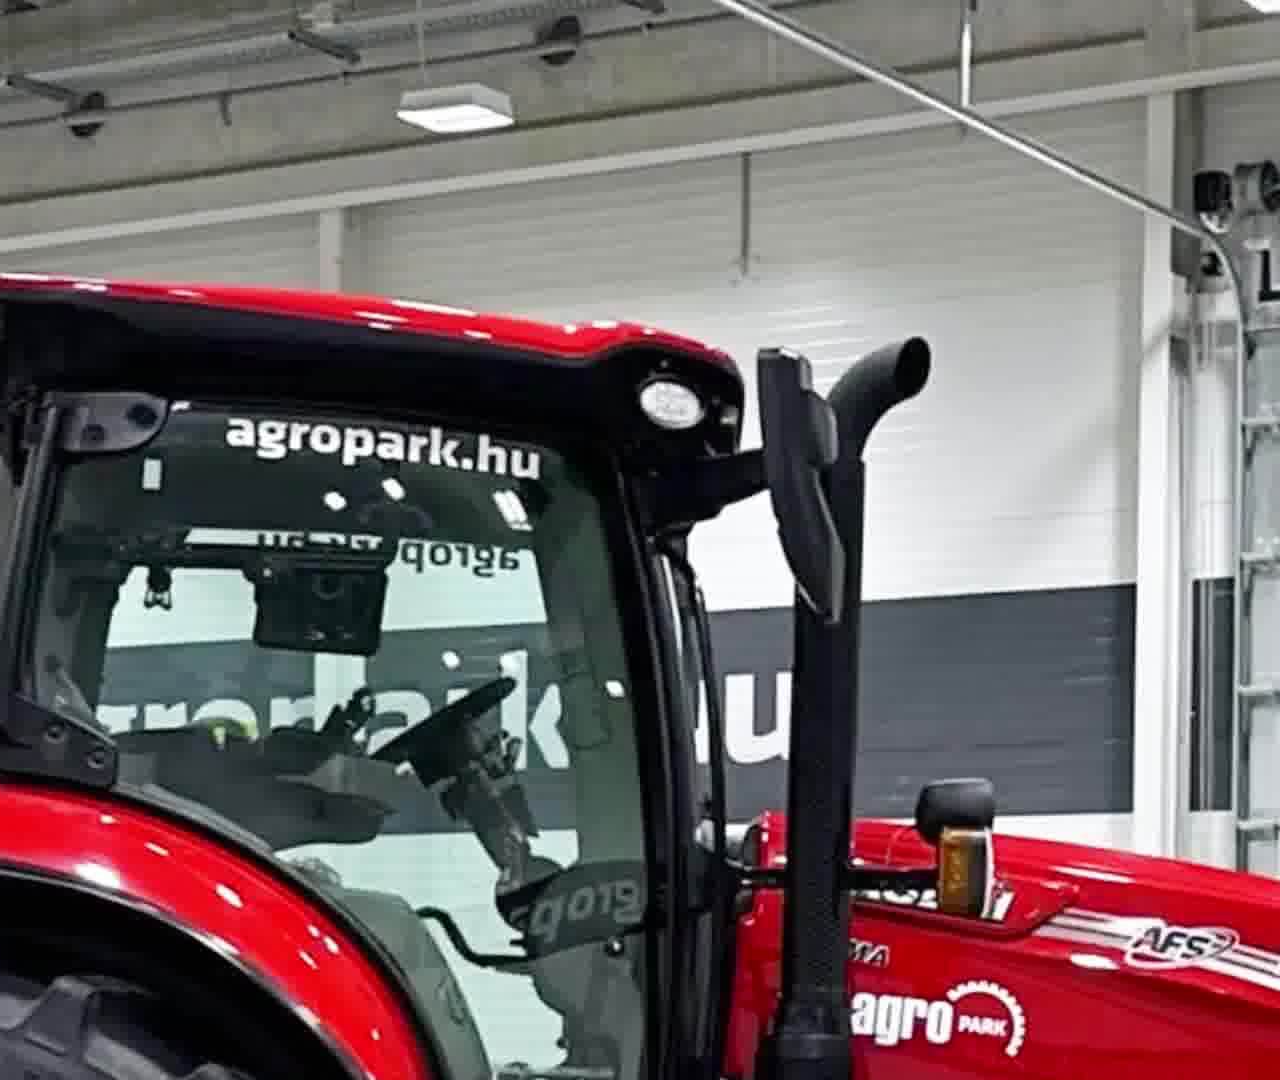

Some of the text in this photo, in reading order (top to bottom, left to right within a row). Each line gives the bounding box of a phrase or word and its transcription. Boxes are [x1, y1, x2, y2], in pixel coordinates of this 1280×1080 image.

[225, 417, 541, 480] agropark.hu
[851, 992, 953, 1047] agro
[958, 1014, 1009, 1038] PARK
